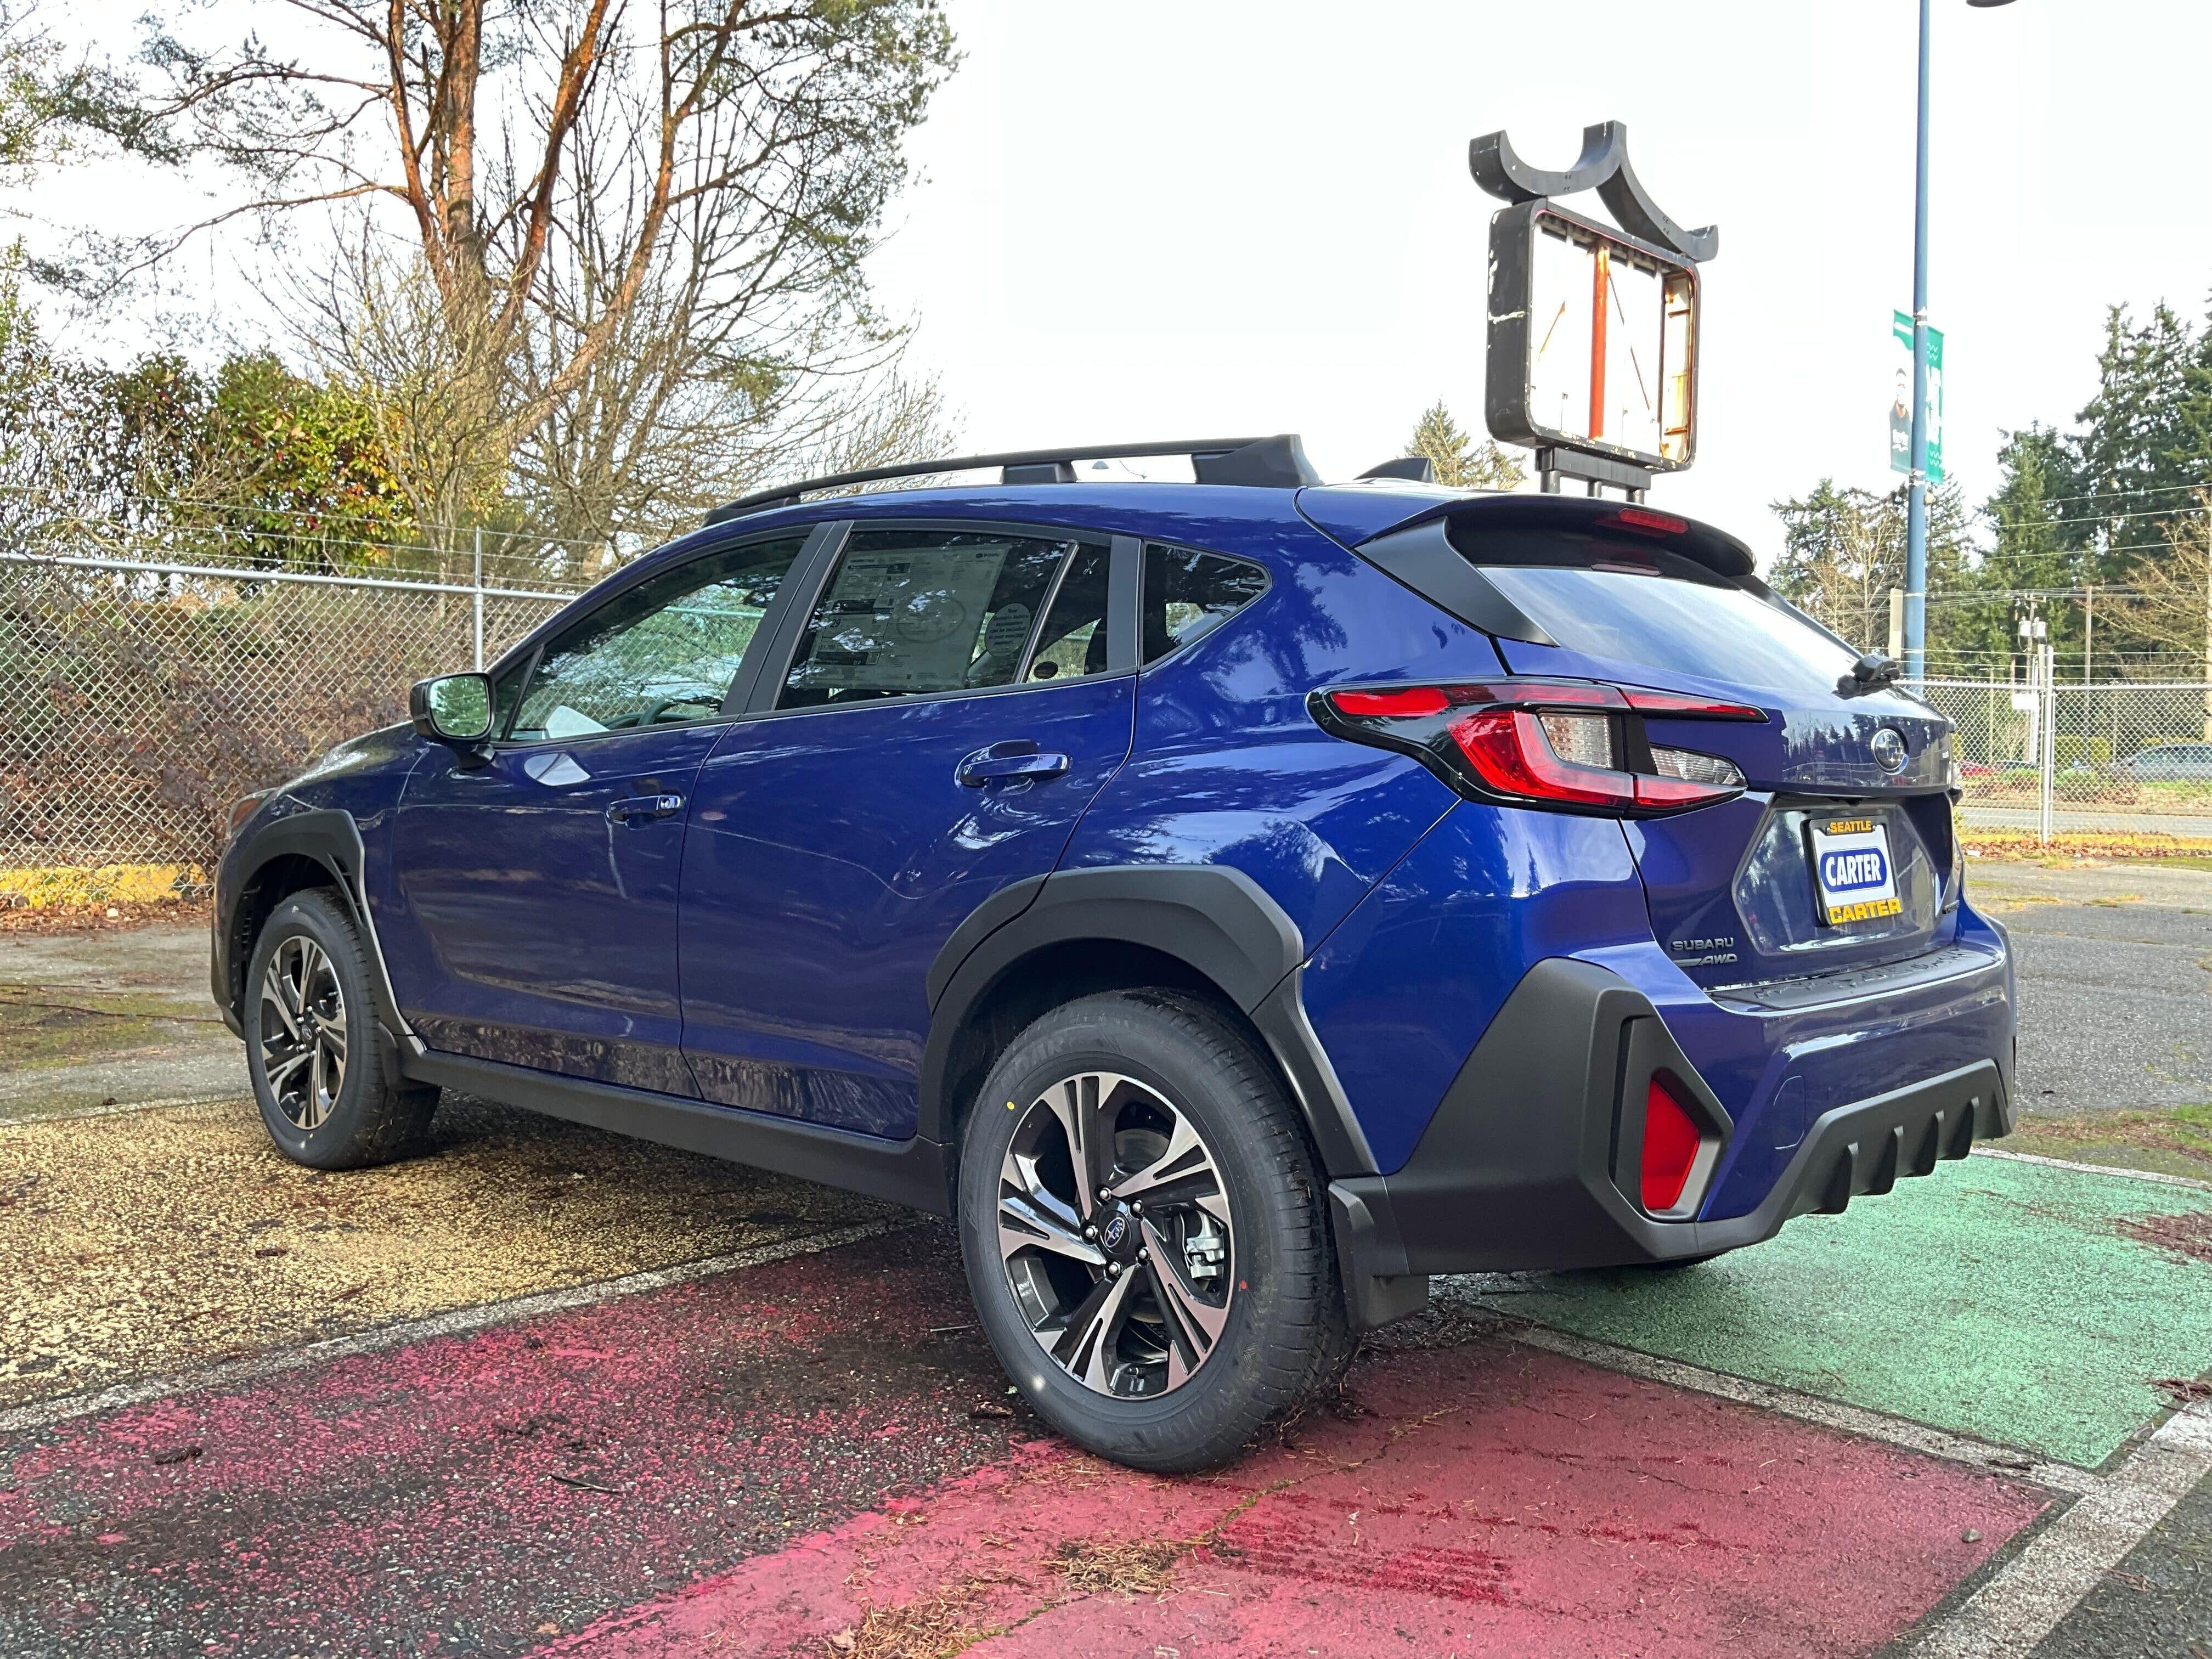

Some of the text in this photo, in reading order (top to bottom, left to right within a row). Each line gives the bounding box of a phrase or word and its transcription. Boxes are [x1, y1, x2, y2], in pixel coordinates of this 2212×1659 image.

[830, 618, 842, 628] 29
[1830, 820, 1872, 834] SEATTLE
[1825, 853, 1882, 887] CARTER
[1829, 898, 1902, 924] CARTER
[1671, 937, 1734, 951] SUBARU
[1699, 953, 1738, 966] AWD
